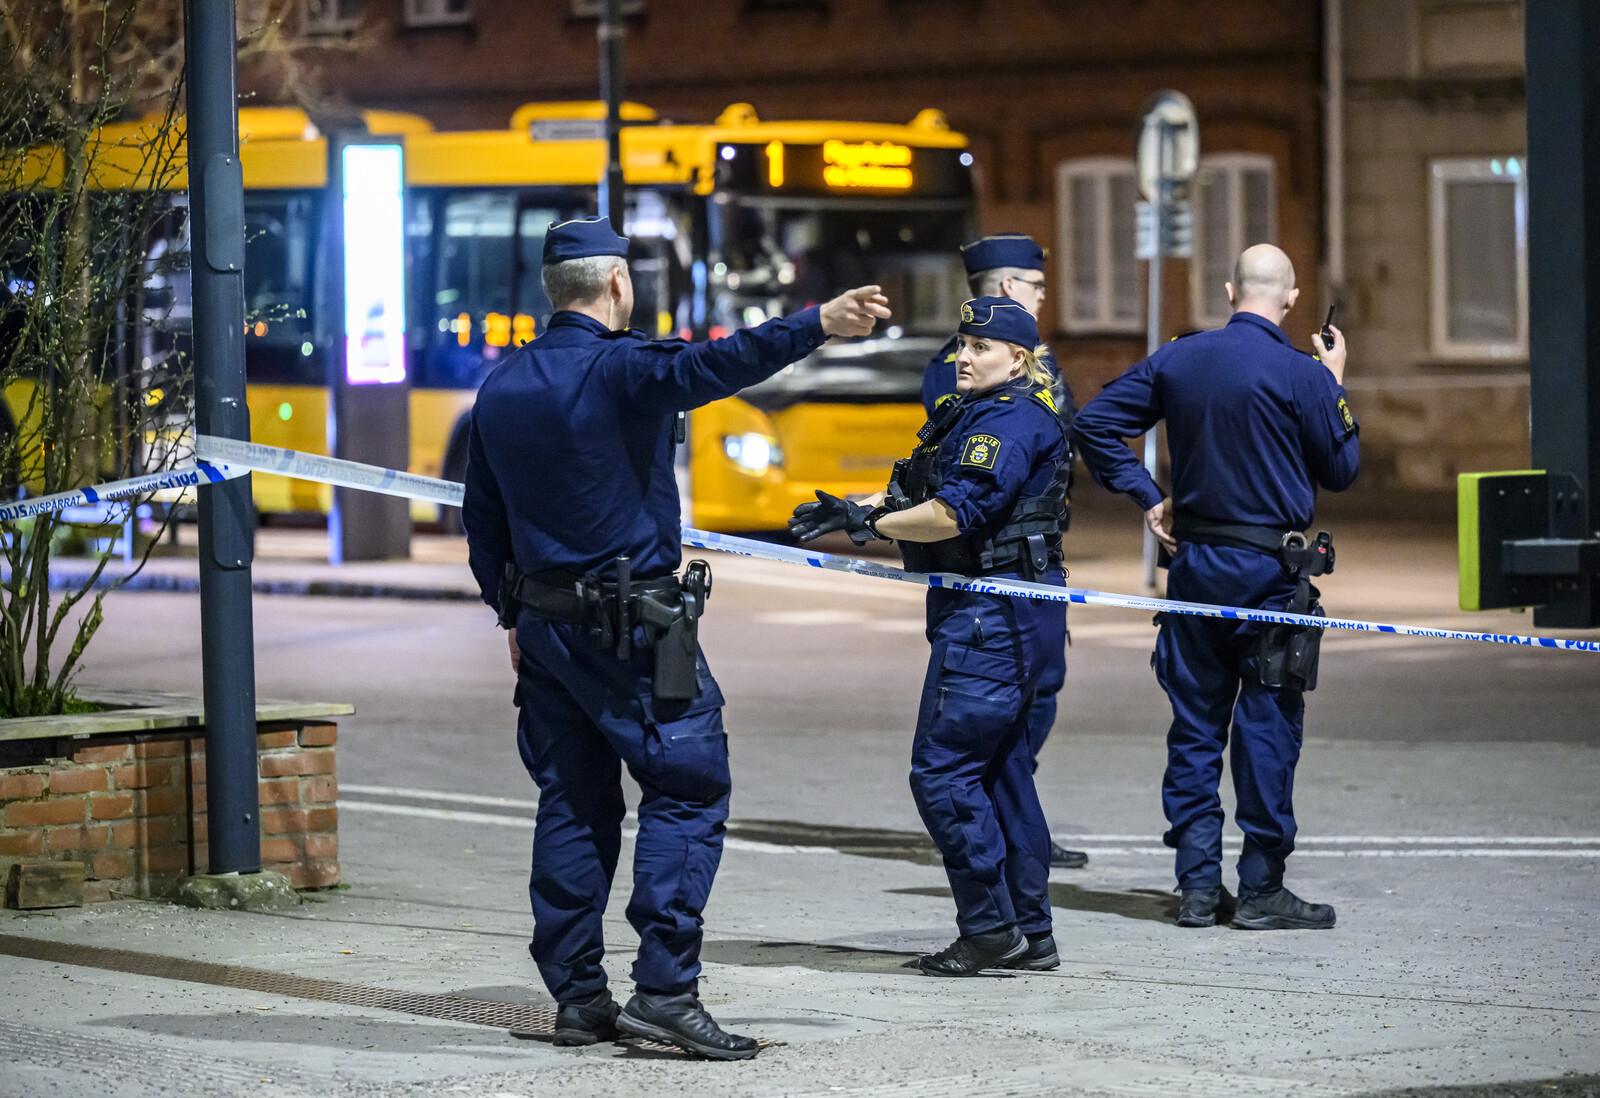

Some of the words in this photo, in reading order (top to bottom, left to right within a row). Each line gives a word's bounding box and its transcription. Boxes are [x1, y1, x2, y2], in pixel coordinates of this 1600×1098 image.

[971, 436, 998, 447] POLIS
[0, 504, 27, 521] OLIS
[1565, 639, 1600, 652] POL
